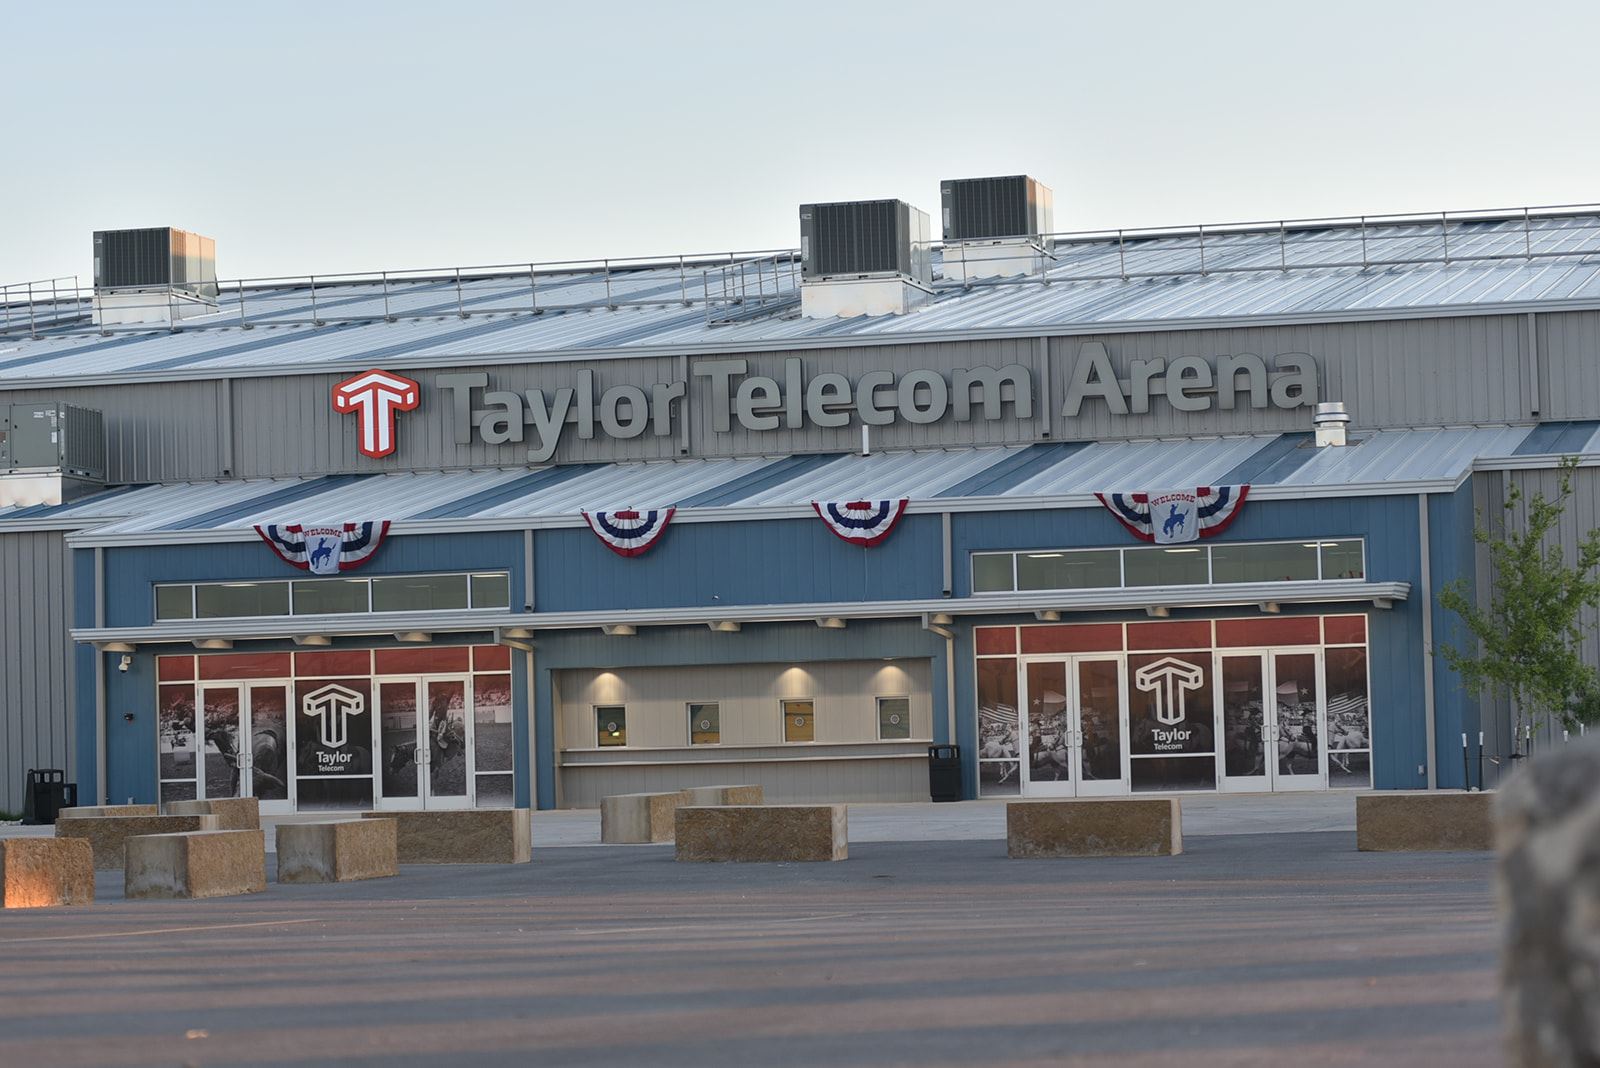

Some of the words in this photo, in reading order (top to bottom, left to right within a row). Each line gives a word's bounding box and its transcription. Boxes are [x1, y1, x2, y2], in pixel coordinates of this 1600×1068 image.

[435, 369, 686, 463] Taylor
[693, 357, 1032, 433] Telecom
[1061, 341, 1319, 417] Arena
[1151, 493, 1196, 507] WELCOME
[303, 528, 342, 538] WELCOME
[1151, 728, 1192, 744] Taylor
[1153, 743, 1183, 751] Telecom
[315, 750, 353, 766] Taylor
